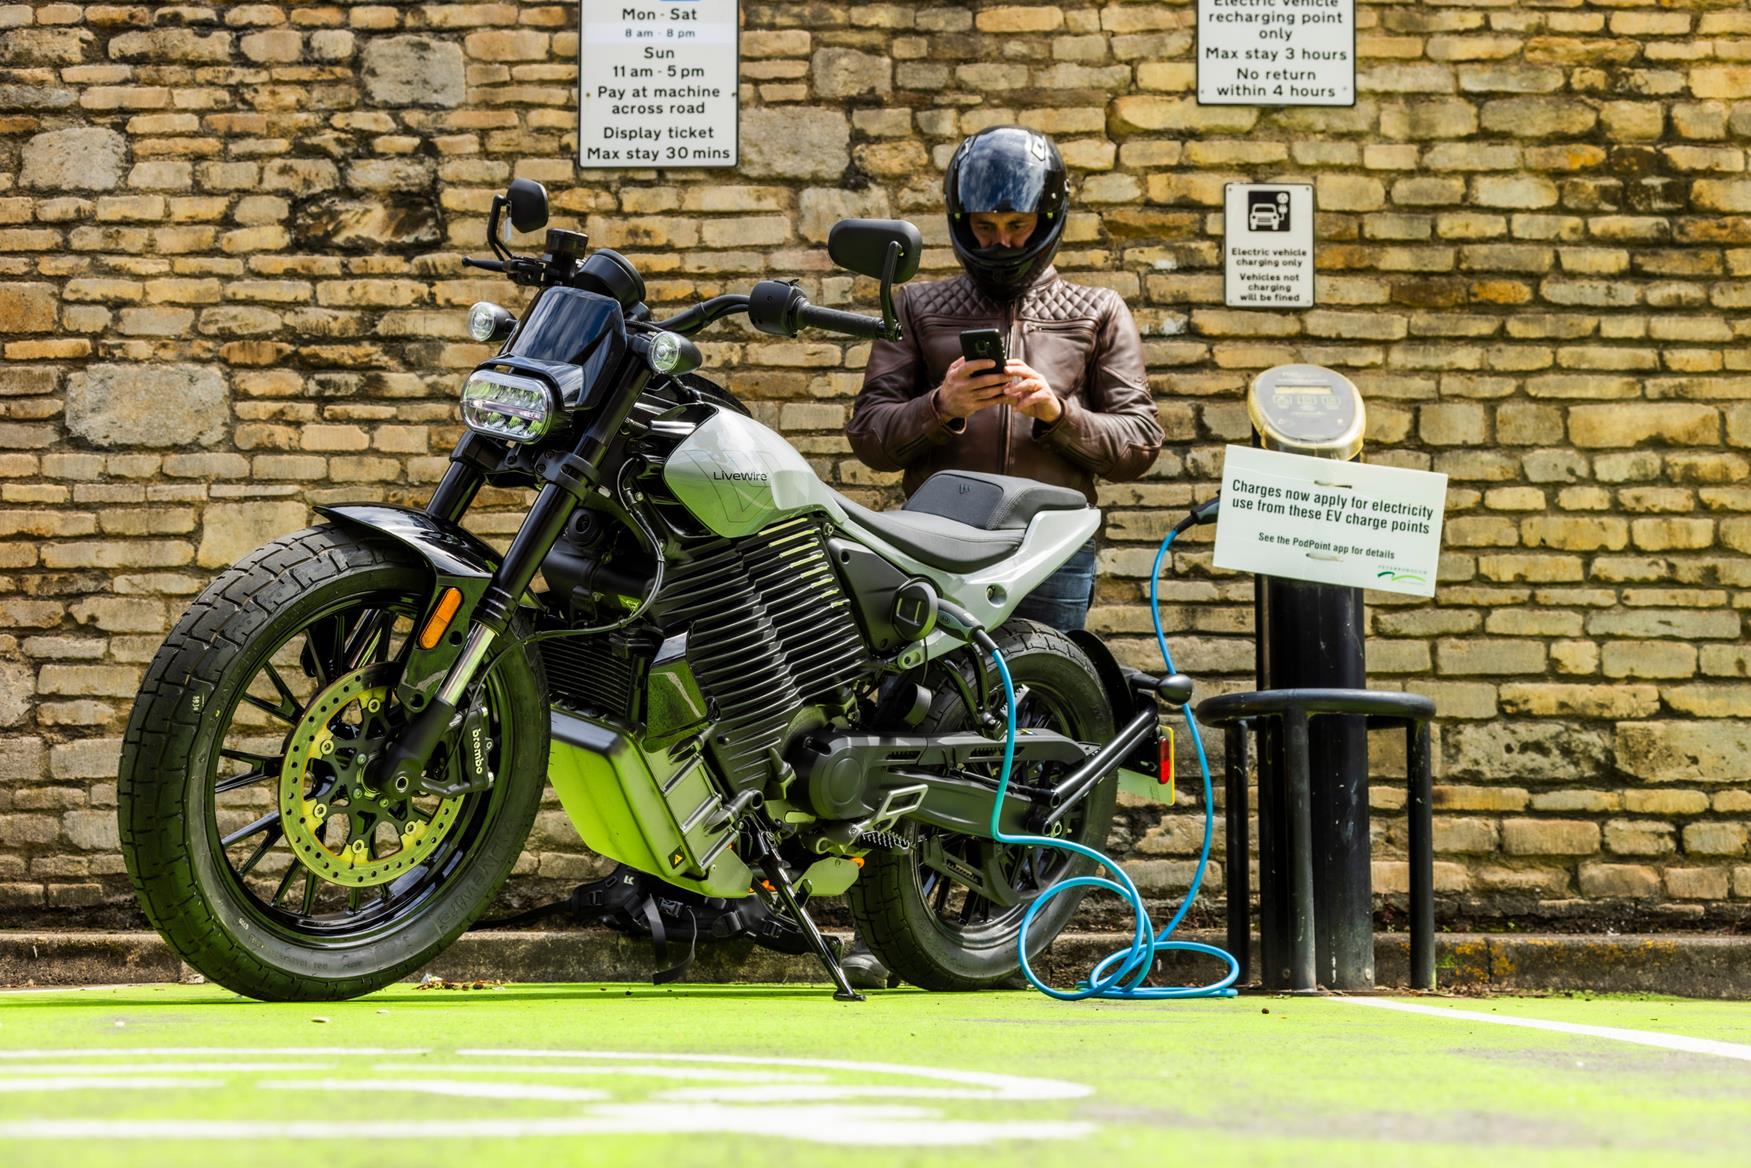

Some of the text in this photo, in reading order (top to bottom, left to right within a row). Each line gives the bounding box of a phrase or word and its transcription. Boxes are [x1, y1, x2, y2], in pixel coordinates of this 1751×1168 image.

[623, 9, 655, 20] Mon
[670, 8, 696, 20] Sat
[1209, 11, 1342, 25] recharging point
[625, 29, 632, 37] 8
[667, 29, 673, 37] 8
[1259, 28, 1292, 41] only
[644, 47, 674, 59] Sun
[1206, 48, 1347, 62] Max stay 3 hours
[614, 66, 625, 77] 11
[631, 68, 653, 77] am
[668, 65, 676, 77] 5
[681, 68, 704, 79] pm
[1237, 68, 1316, 80] No return
[598, 86, 720, 100] Pay at machine
[1217, 85, 1335, 97] within 4 hours
[612, 102, 704, 114] across road
[604, 127, 713, 141] Display ticket
[588, 147, 730, 161] Max stay 30 mins
[1232, 248, 1269, 256] Electric
[1236, 258, 1302, 267] charging only
[1248, 284, 1291, 293] charging
[713, 470, 767, 481] LiveWire
[1232, 479, 1433, 520] Charges now apply for electricity
[1232, 497, 1430, 534] use from these EV charge points
[1258, 532, 1395, 560] See the PodPoint app for details
[472, 728, 484, 774] brembo
